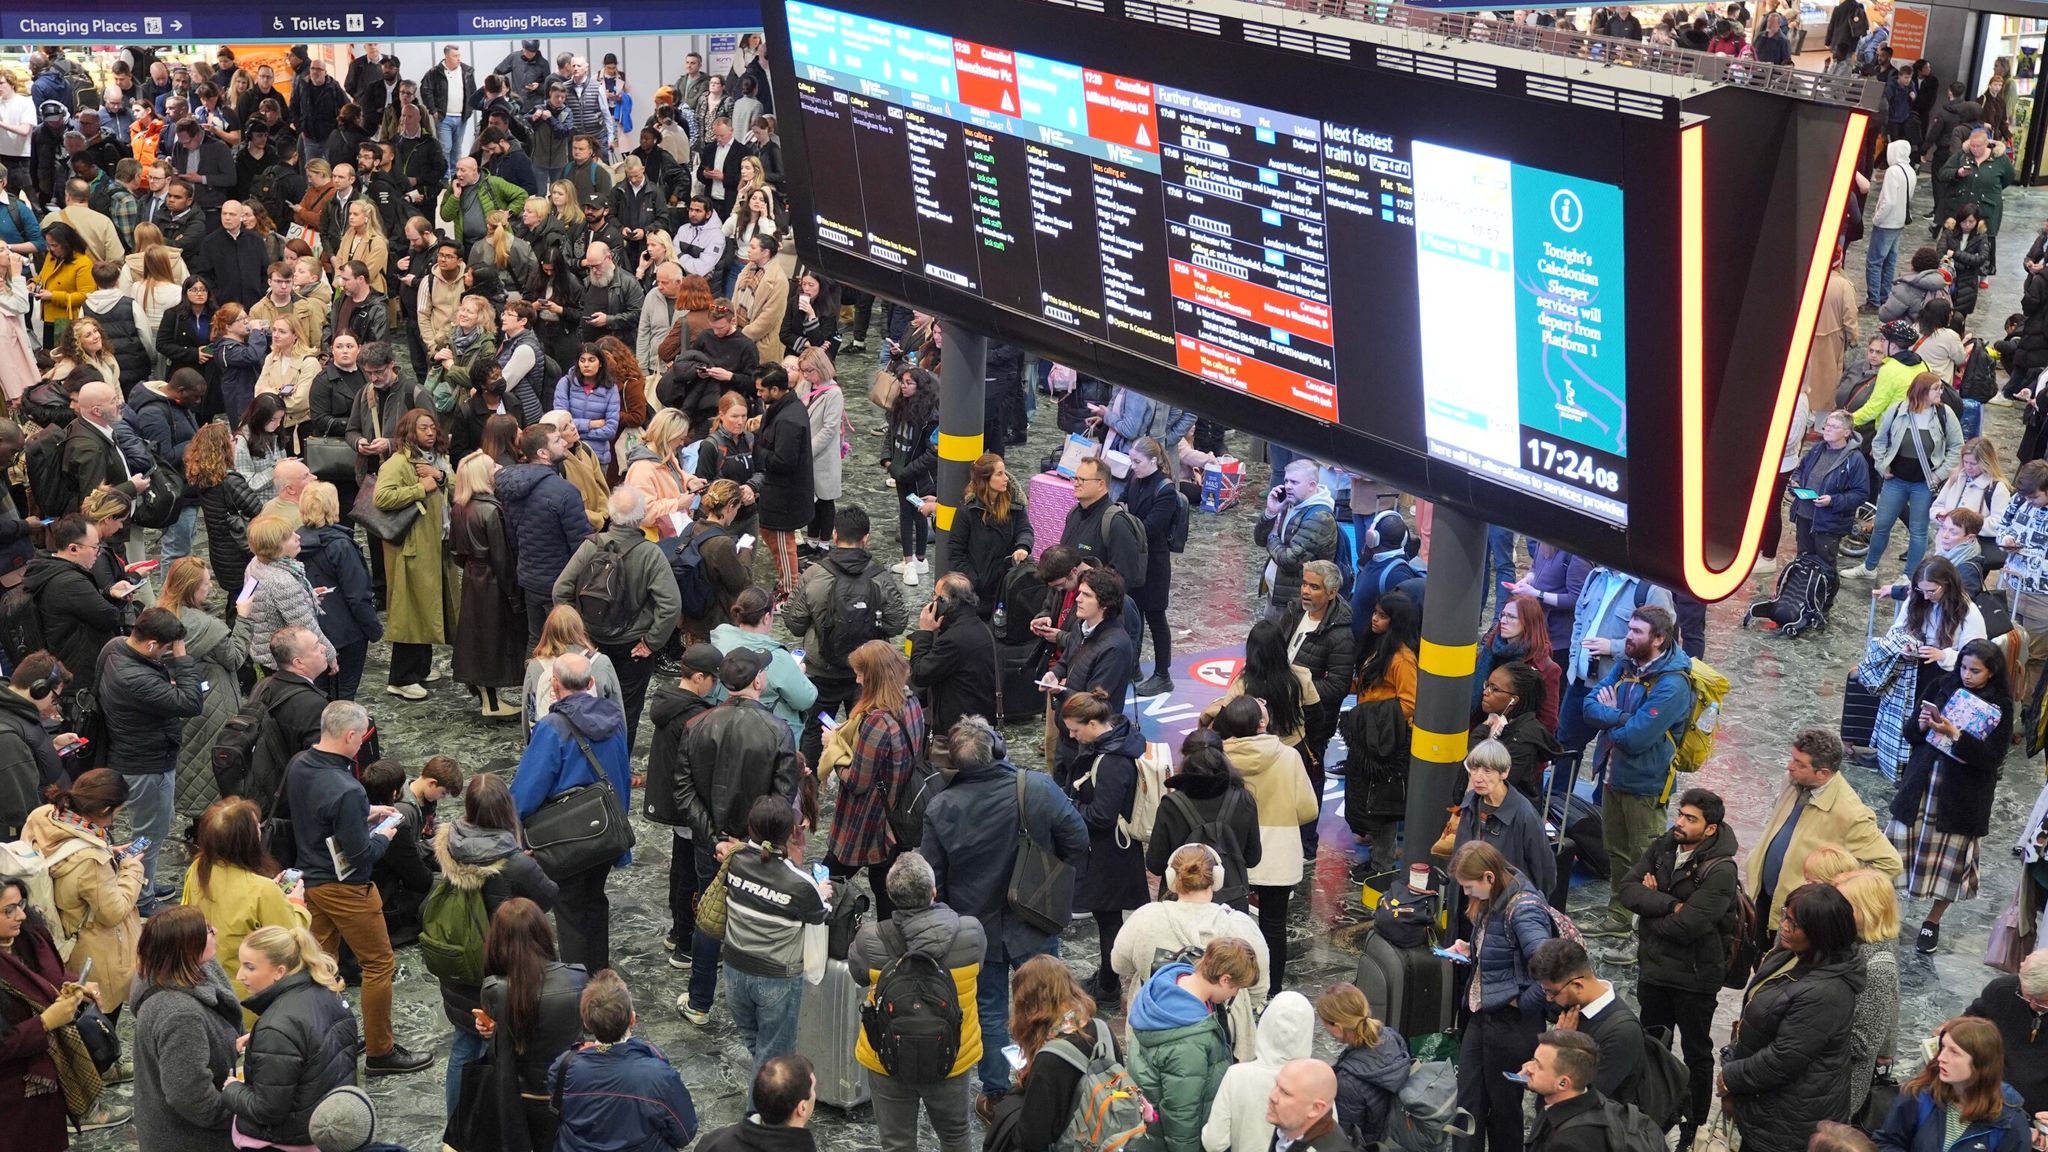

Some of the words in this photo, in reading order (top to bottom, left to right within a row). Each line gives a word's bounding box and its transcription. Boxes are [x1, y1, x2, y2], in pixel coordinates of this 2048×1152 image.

[19, 19, 89, 35] Changing
[92, 19, 138, 32] Places
[290, 17, 341, 31] Toilets
[472, 16, 528, 30] Changing
[530, 15, 567, 27] Places
[955, 58, 999, 79] Manchester
[980, 47, 1012, 65] Cancelled
[1114, 78, 1149, 96] Cancelled
[1110, 95, 1137, 115] Keynes
[1159, 88, 1191, 107] Further
[1192, 96, 1241, 122] departures
[1294, 125, 1316, 140] Update
[1179, 112, 1188, 122] via
[1188, 114, 1221, 132] Birmingham
[1221, 122, 1234, 133] New
[1292, 139, 1317, 155] Delayed
[1180, 124, 1199, 139] Calling
[1323, 122, 1351, 143] Next
[1352, 127, 1393, 153] fastest
[1324, 141, 1351, 164] train
[1353, 149, 1367, 167] to
[1373, 156, 1388, 171] Page
[1394, 161, 1402, 173] of
[1183, 152, 1208, 168] Liverpool
[1208, 158, 1221, 170] Lime
[1296, 180, 1319, 197] Delayed
[1287, 162, 1302, 174] West
[1325, 165, 1359, 182] Destination
[1380, 178, 1393, 190] Plat
[1395, 181, 1412, 195] Time
[1184, 164, 1202, 179] Calling
[1252, 182, 1263, 193] and
[1263, 185, 1289, 202] Liverpool
[1290, 192, 1304, 203] Lime
[1305, 195, 1312, 205] St
[1325, 180, 1354, 196] Willesden
[1354, 188, 1368, 202] Junc
[1396, 198, 1413, 211] 17:57
[1289, 204, 1305, 216] West
[1326, 195, 1372, 218] Wolverhampton
[1396, 213, 1414, 226] 18:16
[1298, 221, 1322, 238] Delayed
[1263, 236, 1285, 251] London
[1285, 242, 1324, 262] Northwestern
[1543, 240, 1592, 270] Tonight's
[1301, 262, 1325, 279] Delayed
[1537, 257, 1598, 287] Caledonian
[1295, 285, 1310, 297] West
[1548, 277, 1589, 305] Sleeper
[1536, 293, 1578, 317] services
[1580, 303, 1601, 322] will
[1537, 310, 1572, 336] depart
[1574, 320, 1601, 341] from
[1541, 328, 1587, 355] Platform
[1452, 447, 1467, 463] will
[1468, 453, 1480, 468] be
[1481, 457, 1530, 486] alterations
[1531, 475, 1541, 490] to
[1543, 479, 1581, 504] services
[1527, 435, 1594, 486] 17:24
[1595, 465, 1618, 493] 08
[742, 880, 792, 905] FRANS
